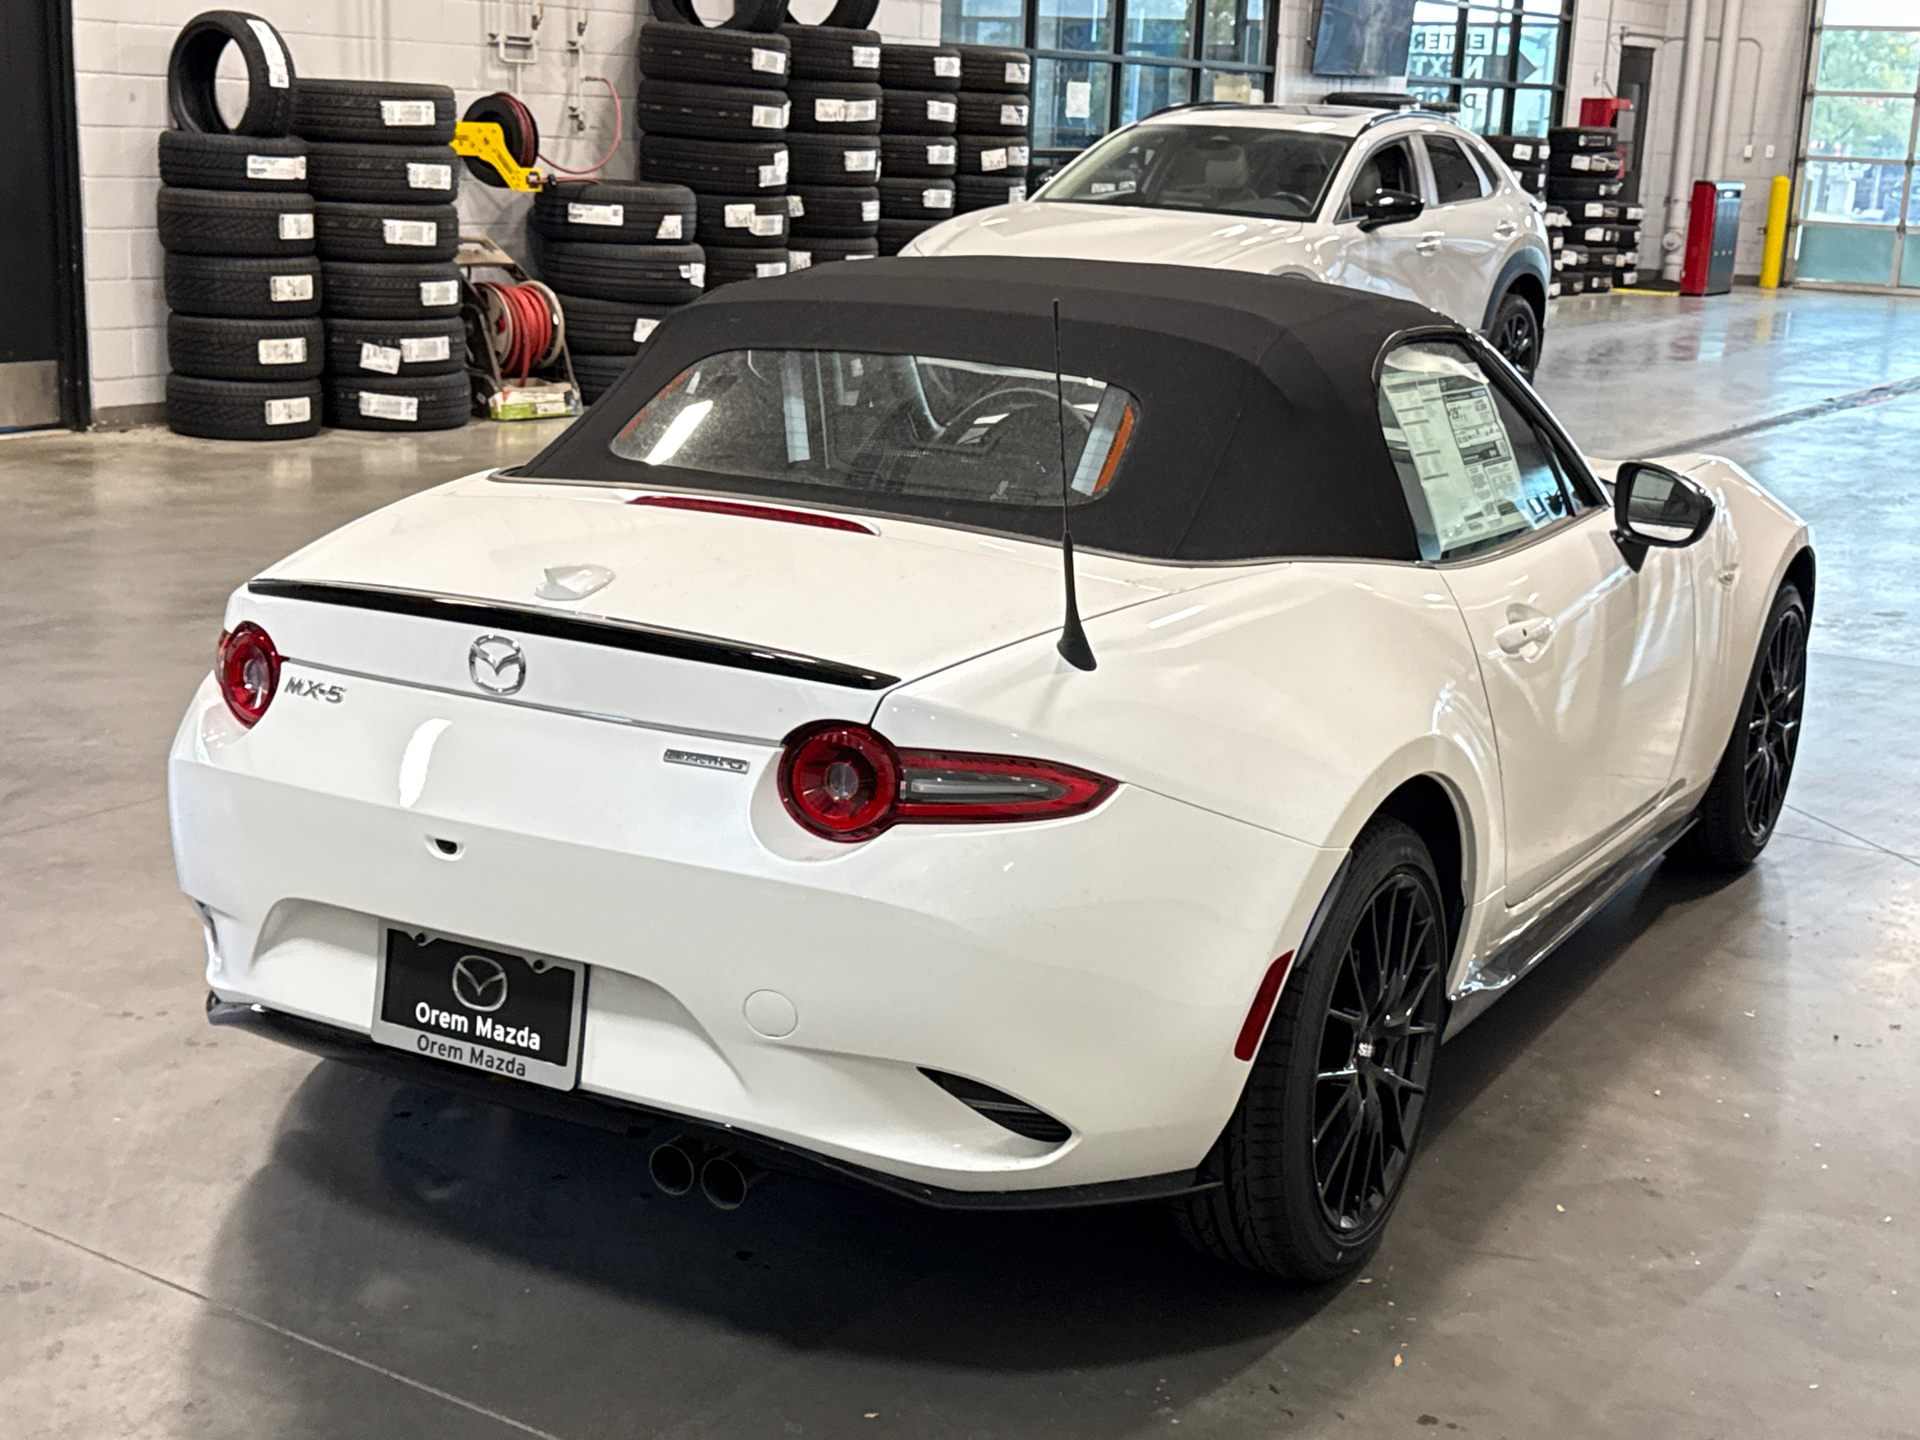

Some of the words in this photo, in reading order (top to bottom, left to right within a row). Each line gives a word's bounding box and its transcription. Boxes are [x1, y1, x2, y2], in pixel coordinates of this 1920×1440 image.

[284, 676, 347, 704] MX-5
[415, 1001, 469, 1034] Orem
[475, 1015, 541, 1051] Mazda
[416, 1034, 463, 1061] Orem
[469, 1046, 526, 1077] Mazda
